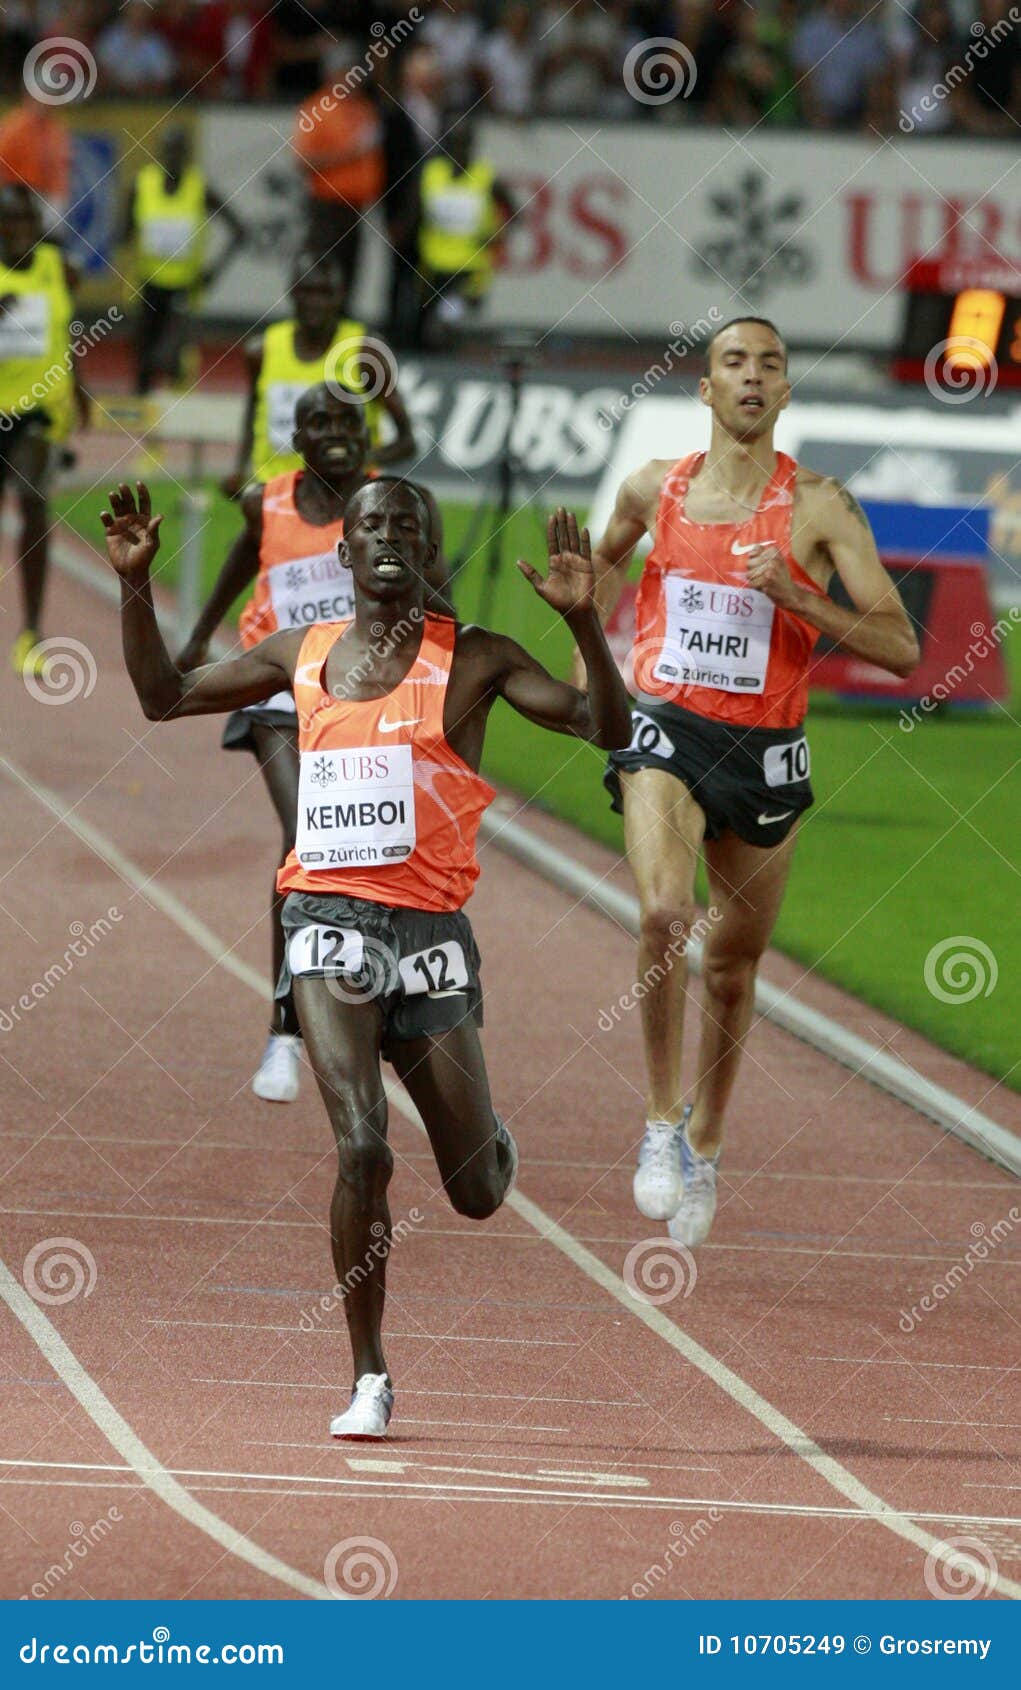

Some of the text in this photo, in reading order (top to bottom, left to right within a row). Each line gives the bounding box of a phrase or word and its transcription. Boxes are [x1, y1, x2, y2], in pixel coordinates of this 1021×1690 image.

[489, 172, 632, 282] BS
[845, 193, 1021, 292] UB
[709, 591, 754, 618] UBS
[679, 627, 749, 659] TAHRI
[341, 754, 390, 781] UBS
[780, 741, 809, 782] 10
[306, 800, 406, 831] KEMBOI
[328, 846, 378, 863] Zürich
[304, 928, 346, 968] 12
[412, 948, 457, 991] 12
